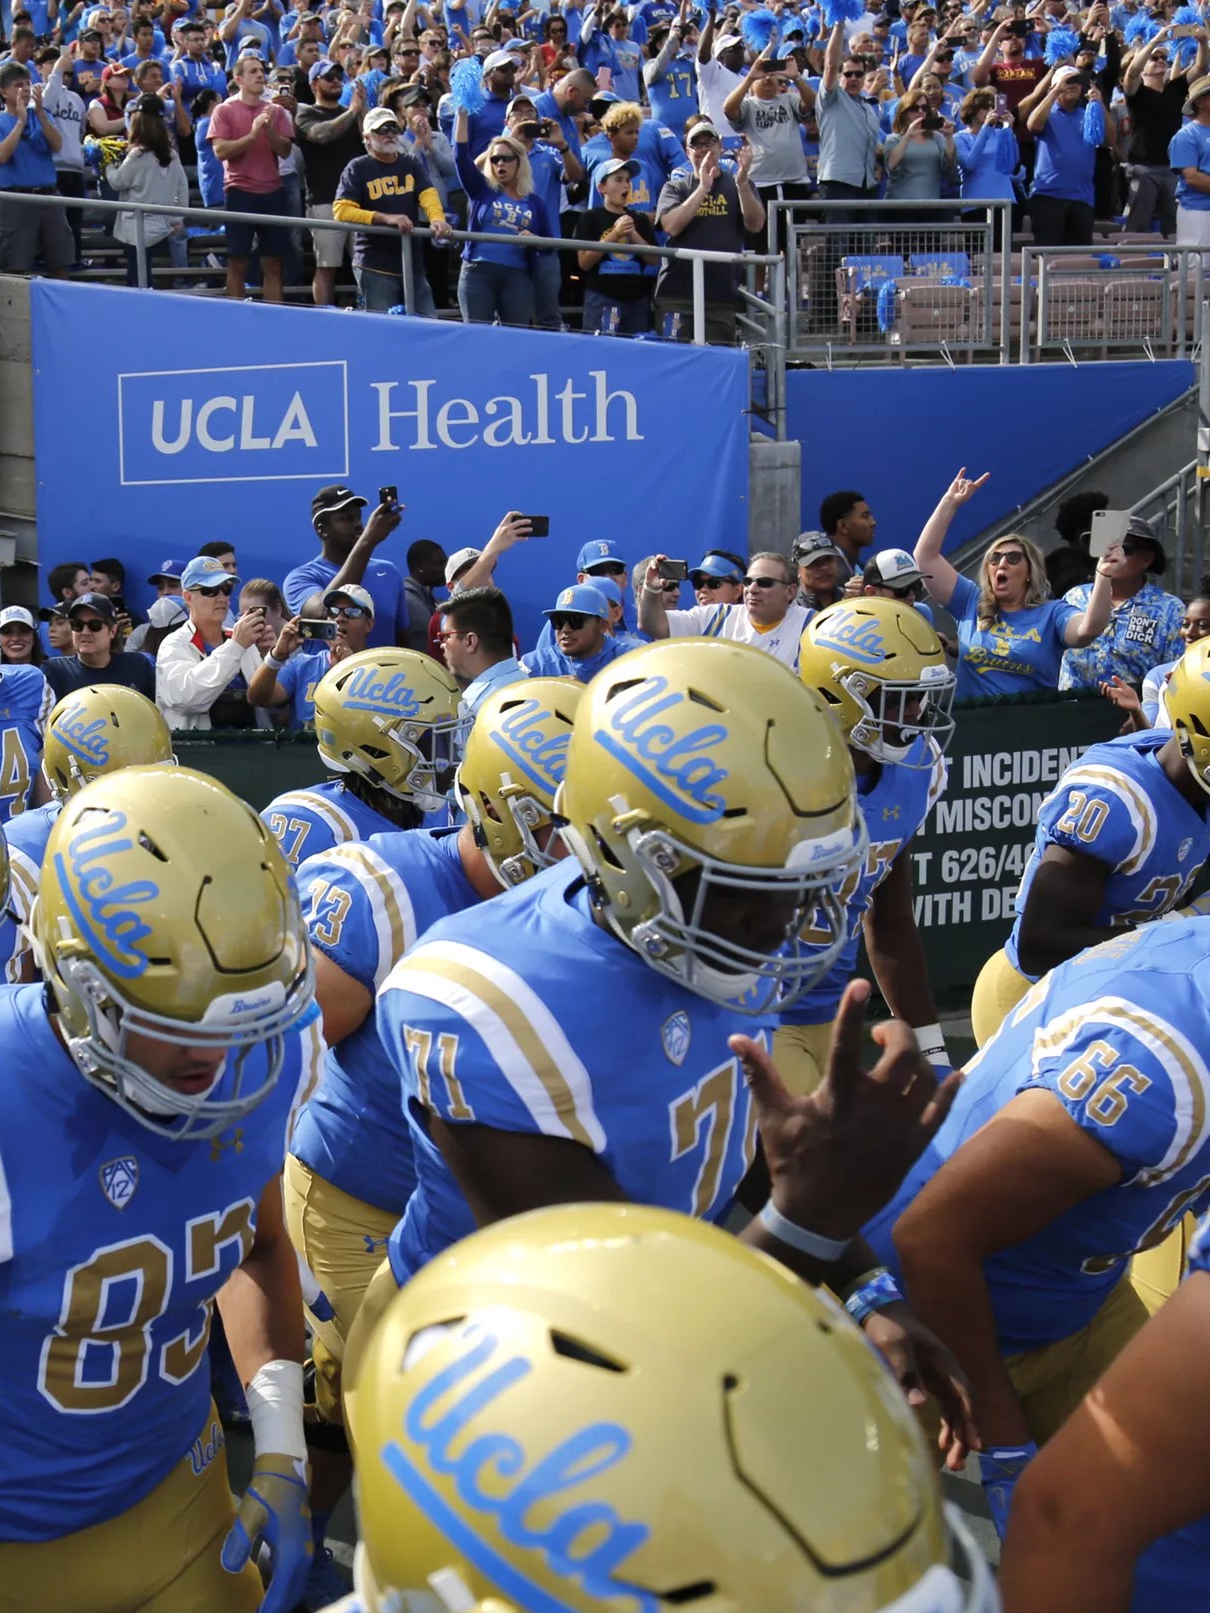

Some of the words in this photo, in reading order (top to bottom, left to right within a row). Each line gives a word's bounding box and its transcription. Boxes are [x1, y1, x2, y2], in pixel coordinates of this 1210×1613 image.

[665, 71, 692, 98] 17
[366, 173, 415, 200] UCLA
[492, 200, 534, 221] UCLA
[151, 390, 318, 455] UCLA
[370, 369, 645, 452] Health
[598, 542, 609, 556] B
[814, 609, 886, 664] Ucla
[980, 617, 1042, 643] CLA
[1126, 631, 1154, 644] DICK
[1128, 624, 1143, 633] BE
[1145, 627, 1154, 635] A
[1130, 616, 1158, 627] DON'T
[964, 646, 1033, 674] Bruins
[341, 666, 421, 718] Ucla
[52, 701, 110, 767] Ucla
[593, 674, 728, 825] Ucla
[963, 745, 1090, 789] INCIDEN
[270, 812, 312, 864] 27
[1056, 789, 1110, 844] 20
[54, 810, 159, 980] Ucla
[303, 877, 353, 947] 73
[981, 886, 1019, 922] DE
[402, 1022, 477, 1121] 71
[1056, 1039, 1154, 1127] 66
[111, 1180, 130, 1200] 12
[380, 1322, 662, 1613] Ucla
